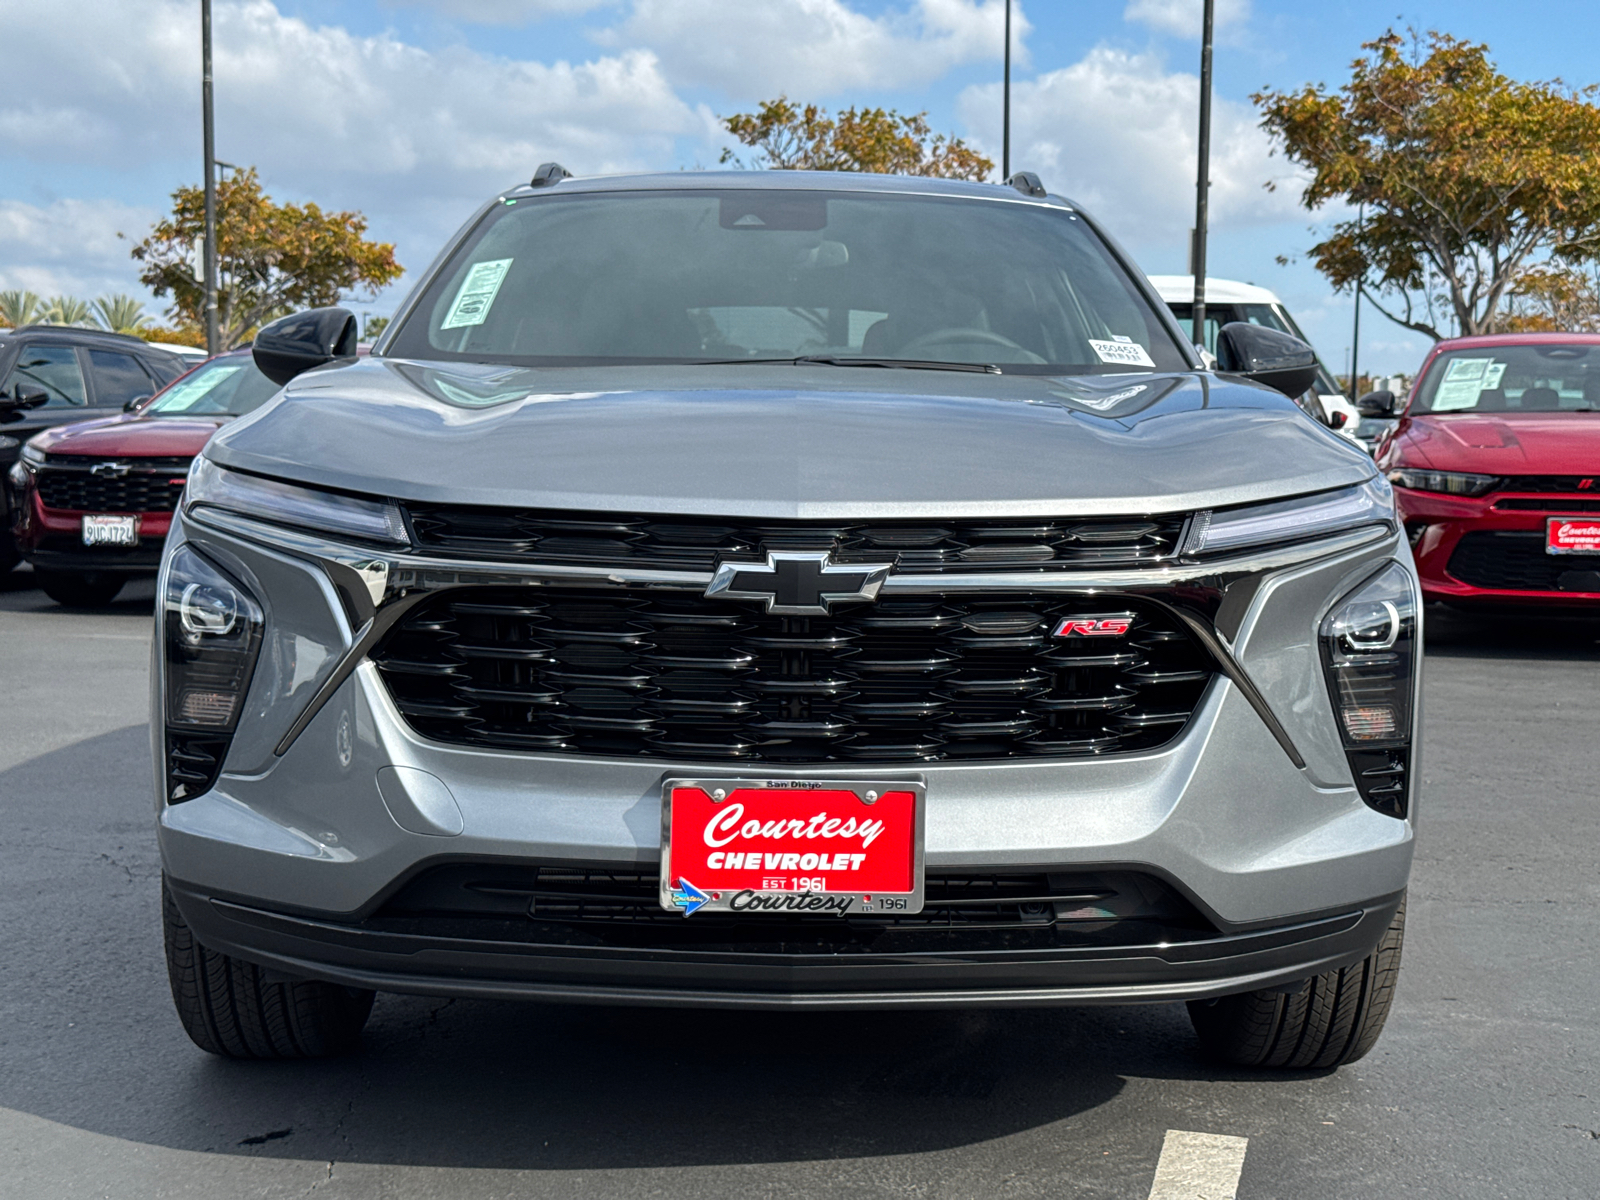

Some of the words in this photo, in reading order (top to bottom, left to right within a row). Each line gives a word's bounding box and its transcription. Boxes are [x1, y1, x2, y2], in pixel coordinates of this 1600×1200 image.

[1053, 618, 1133, 636] RS
[766, 780, 788, 788] San
[790, 780, 822, 790] Diego
[703, 803, 885, 848] Courtesy
[707, 851, 866, 871] CHEVROLET
[762, 879, 787, 889] EST
[791, 877, 826, 892] 1961
[730, 889, 855, 916] Courtesy
[879, 898, 908, 910] 1961
